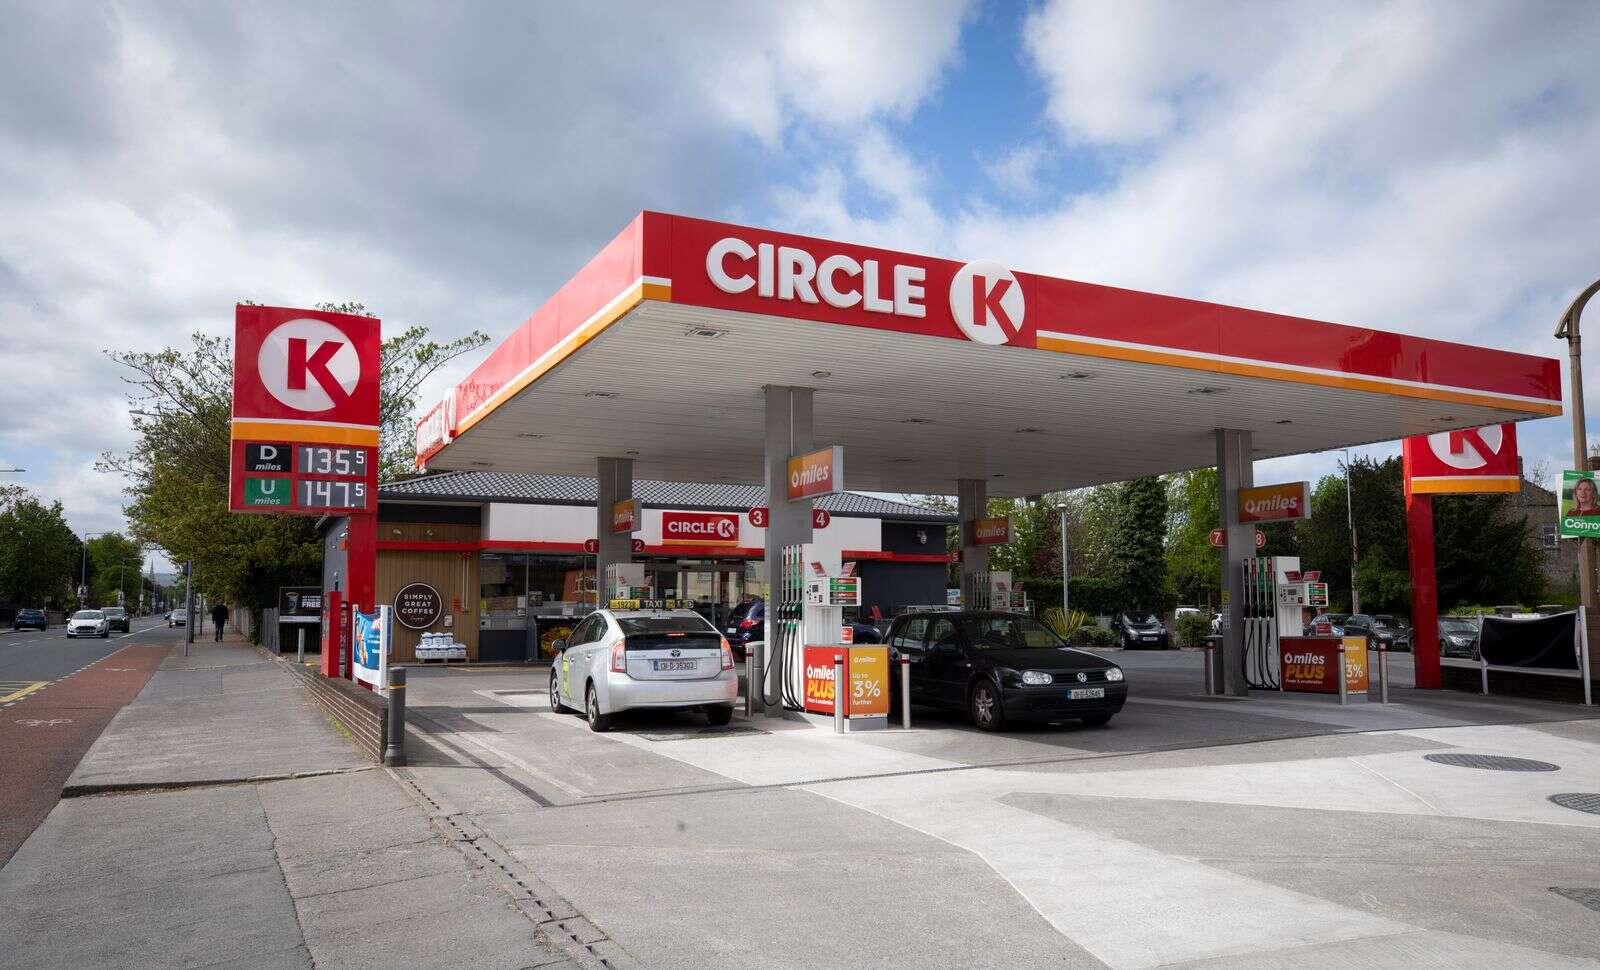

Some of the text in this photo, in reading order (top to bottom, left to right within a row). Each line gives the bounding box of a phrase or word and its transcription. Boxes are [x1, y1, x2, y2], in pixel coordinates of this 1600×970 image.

[706, 237, 926, 318] CIRCLE
[287, 337, 351, 406] K
[260, 445, 278, 461] D
[255, 462, 282, 472] miles
[260, 479, 276, 495] U
[254, 496, 281, 505] miles
[752, 511, 763, 524] 3
[815, 511, 825, 526] 4
[667, 521, 715, 534] CIRCLE
[1564, 518, 1600, 531] Conro
[1213, 532, 1221, 545] 7
[1255, 533, 1263, 546] 8
[634, 541, 642, 551] 2
[644, 600, 663, 608] TAXI
[1285, 664, 1325, 679] PLUS
[1345, 664, 1364, 678] 3%
[807, 680, 835, 699] PLUS
[852, 680, 881, 698] 3%
